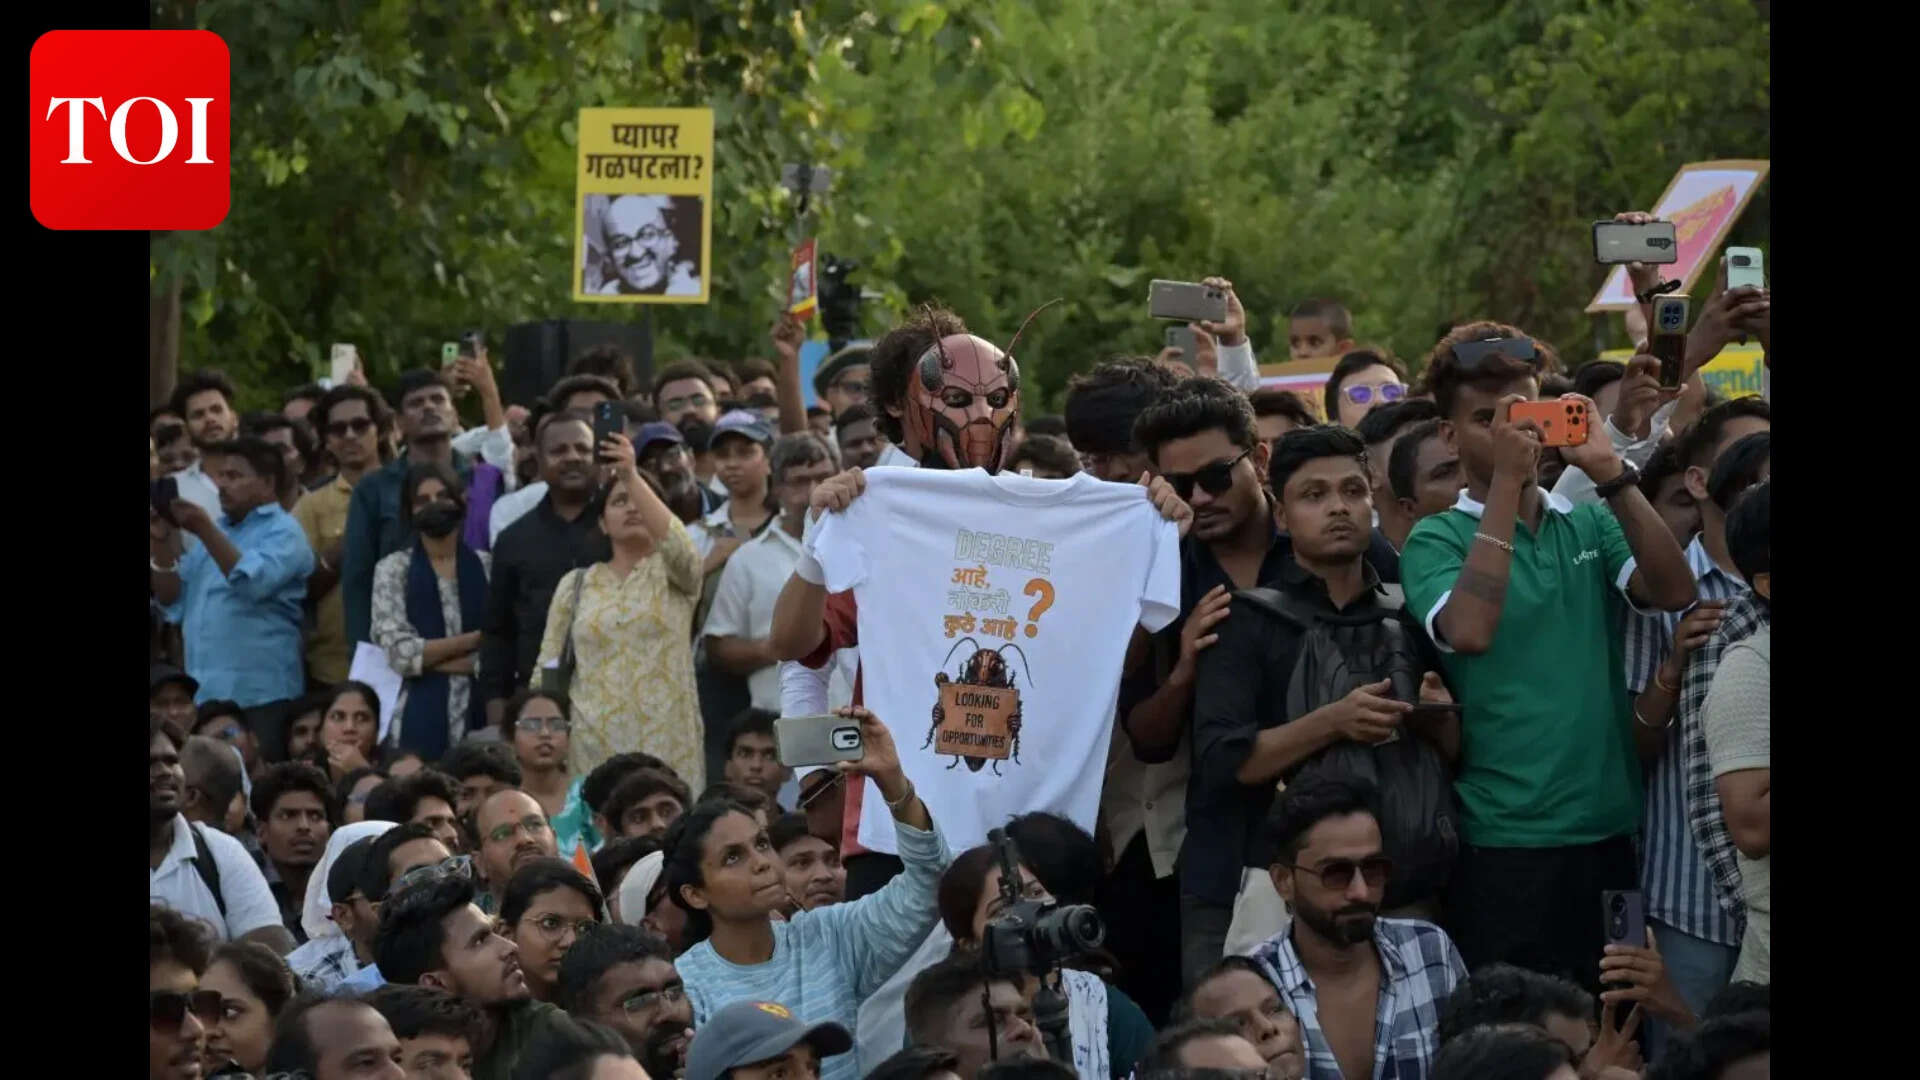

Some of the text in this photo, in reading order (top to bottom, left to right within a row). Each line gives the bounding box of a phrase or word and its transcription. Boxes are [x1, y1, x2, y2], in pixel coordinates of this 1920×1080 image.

[611, 123, 679, 150] प्यापर
[585, 153, 704, 180] गळपटला?
[953, 528, 1054, 575] DEGREE
[951, 564, 990, 589] आहे,
[947, 585, 1011, 615] नोकरी
[943, 611, 976, 638] कुठे
[979, 615, 1018, 641] आहे
[955, 692, 1000, 710] LOOKING
[964, 713, 985, 728] FOR
[942, 729, 1006, 748] OPPORTUNITIES
